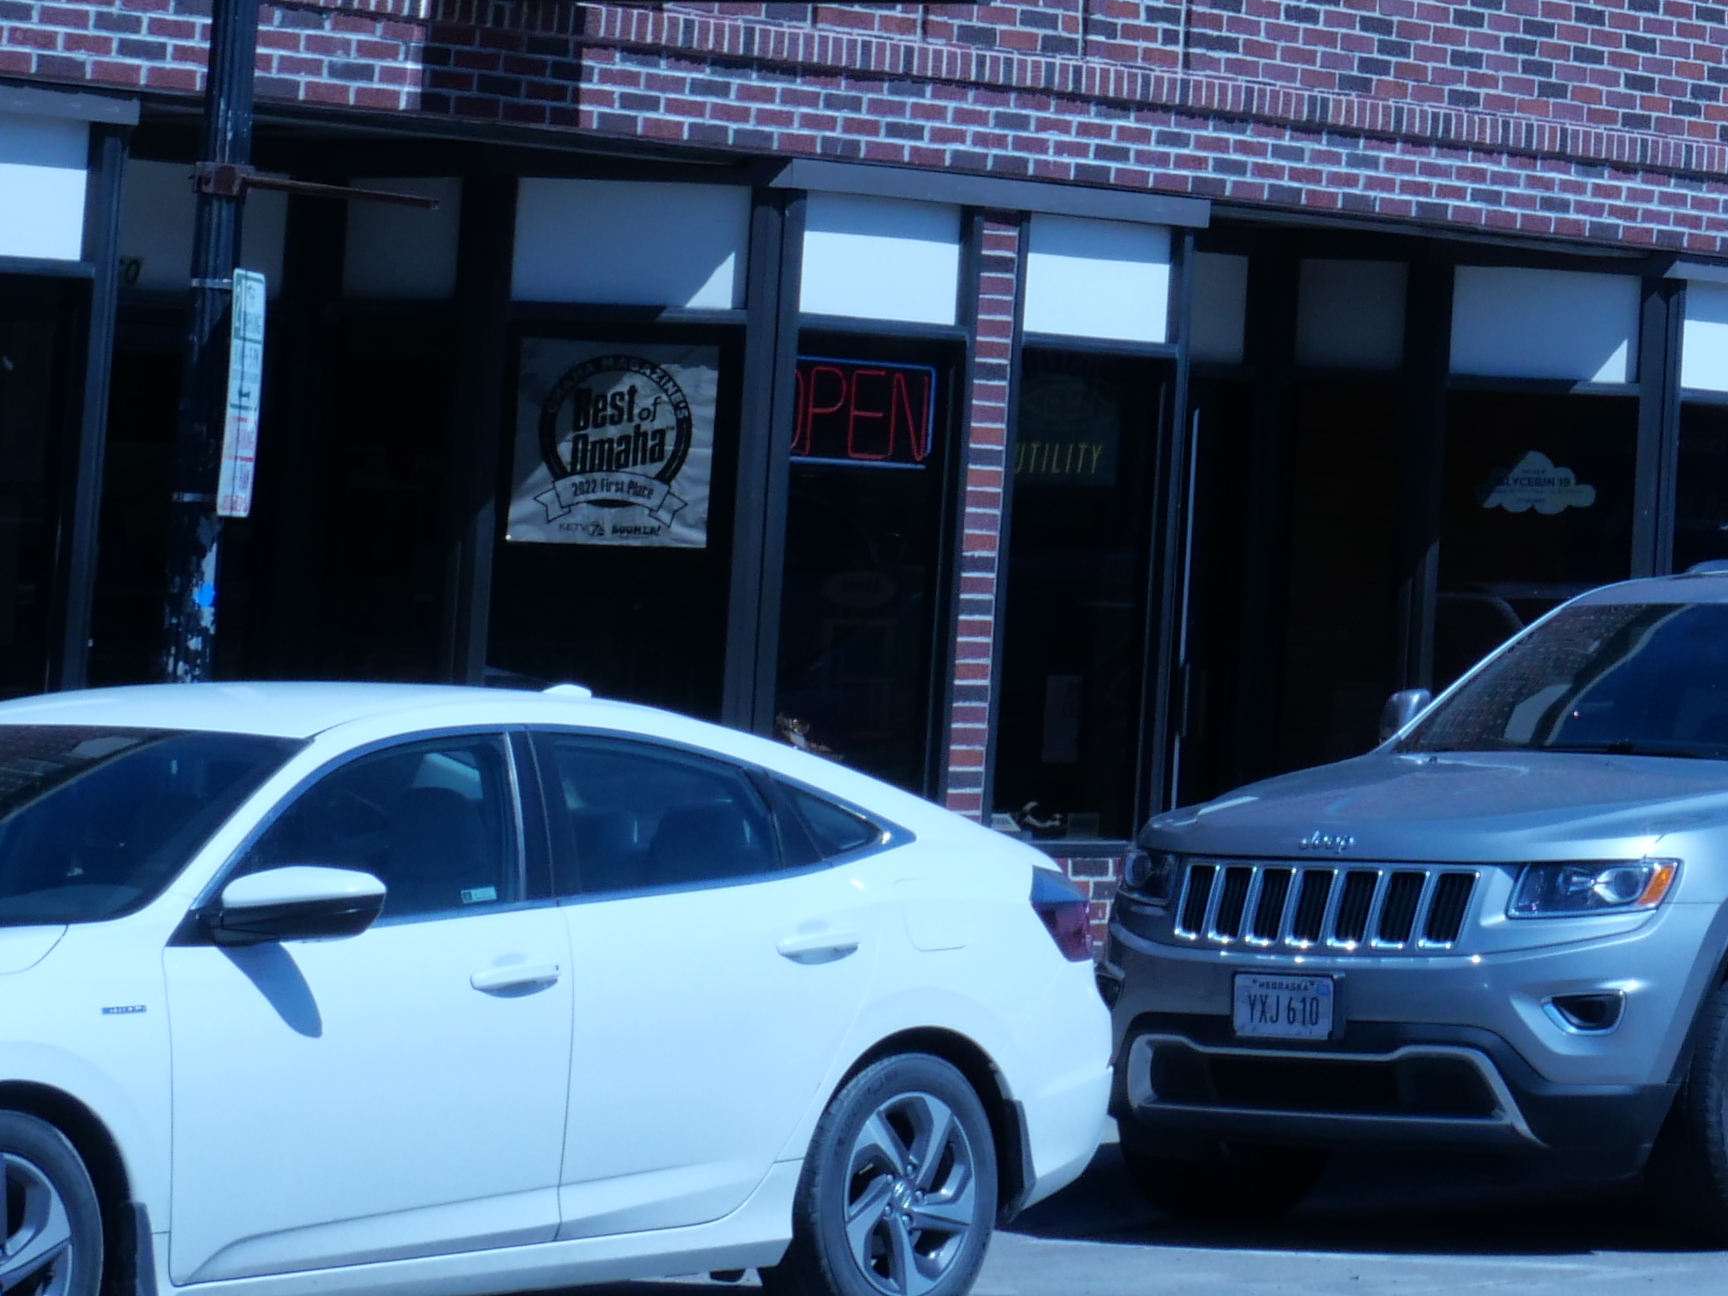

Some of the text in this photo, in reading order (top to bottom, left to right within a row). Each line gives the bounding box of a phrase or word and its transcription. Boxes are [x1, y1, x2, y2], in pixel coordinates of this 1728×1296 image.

[572, 383, 664, 432] Best of
[571, 478, 655, 500] 2022 First Place
[1258, 980, 1309, 991] NEBRASKA
[1247, 993, 1320, 1027] YXJ 610
